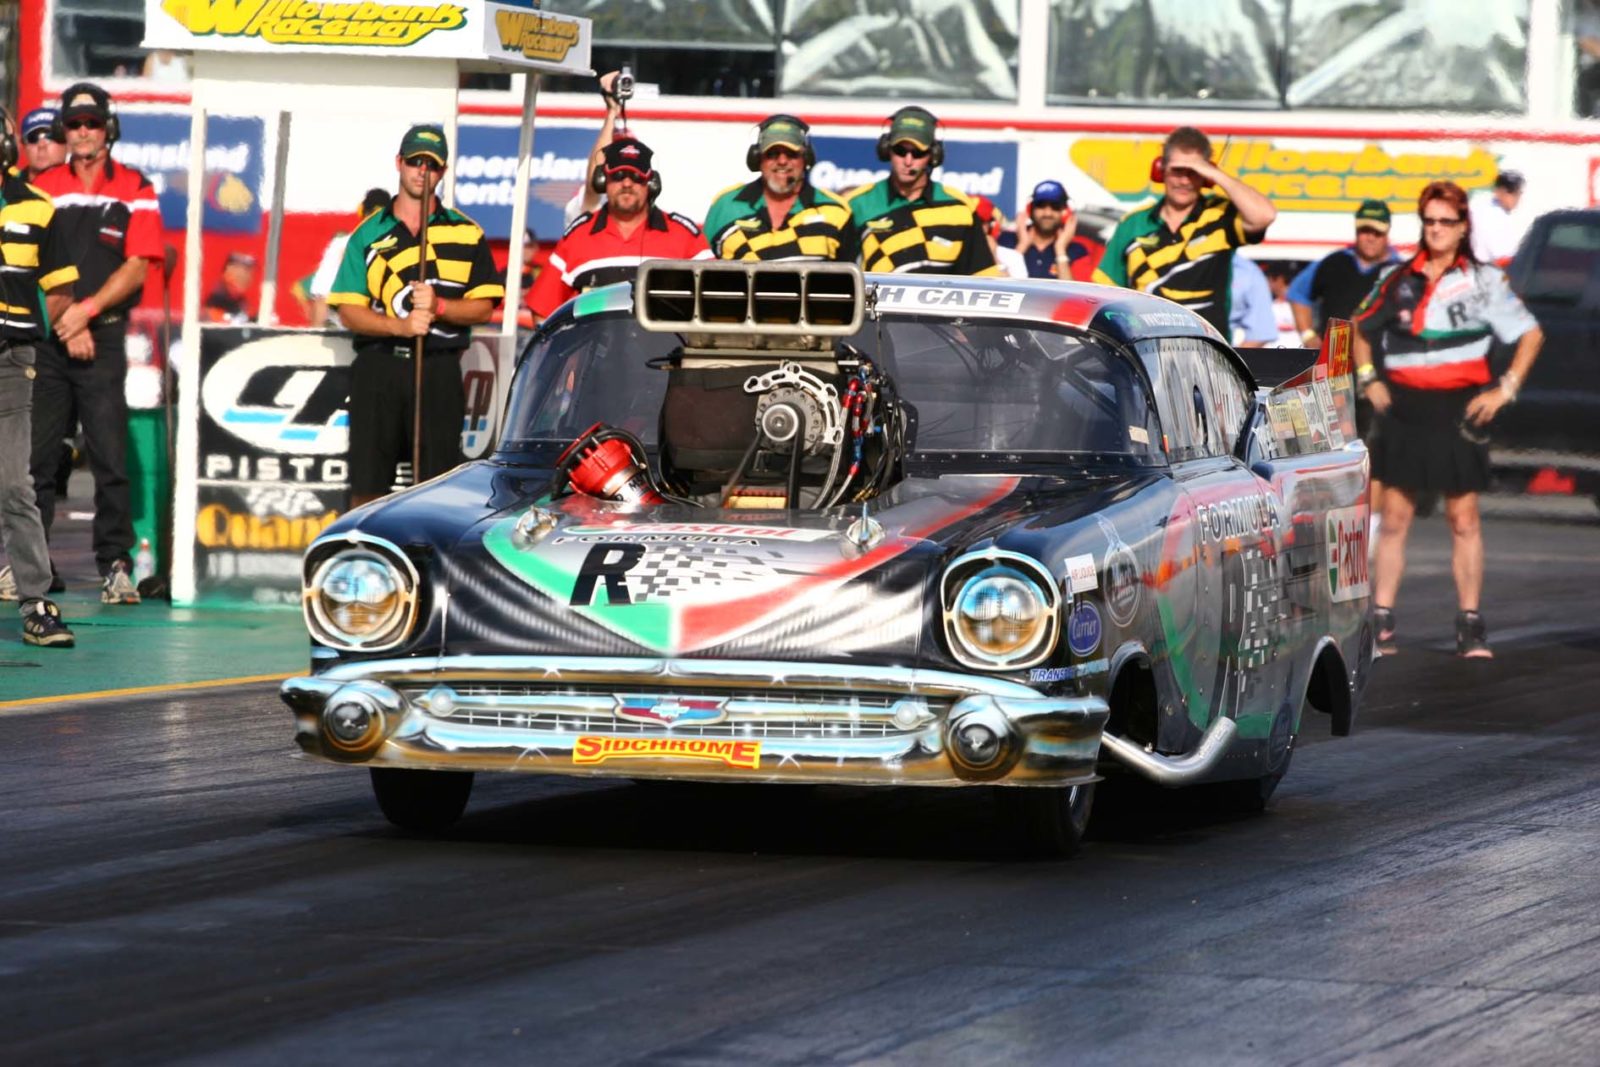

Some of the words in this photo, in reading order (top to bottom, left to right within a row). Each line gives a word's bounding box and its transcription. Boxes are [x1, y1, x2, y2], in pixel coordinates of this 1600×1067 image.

[160, 0, 468, 36] Willowbank
[249, 14, 432, 46] Raceway
[917, 288, 1014, 308] CAFE
[1447, 302, 1467, 328] R
[1197, 491, 1280, 544] FORMULA
[551, 534, 761, 547] FORMULA
[569, 542, 647, 606] R
[575, 736, 760, 764] SIDCHROME
